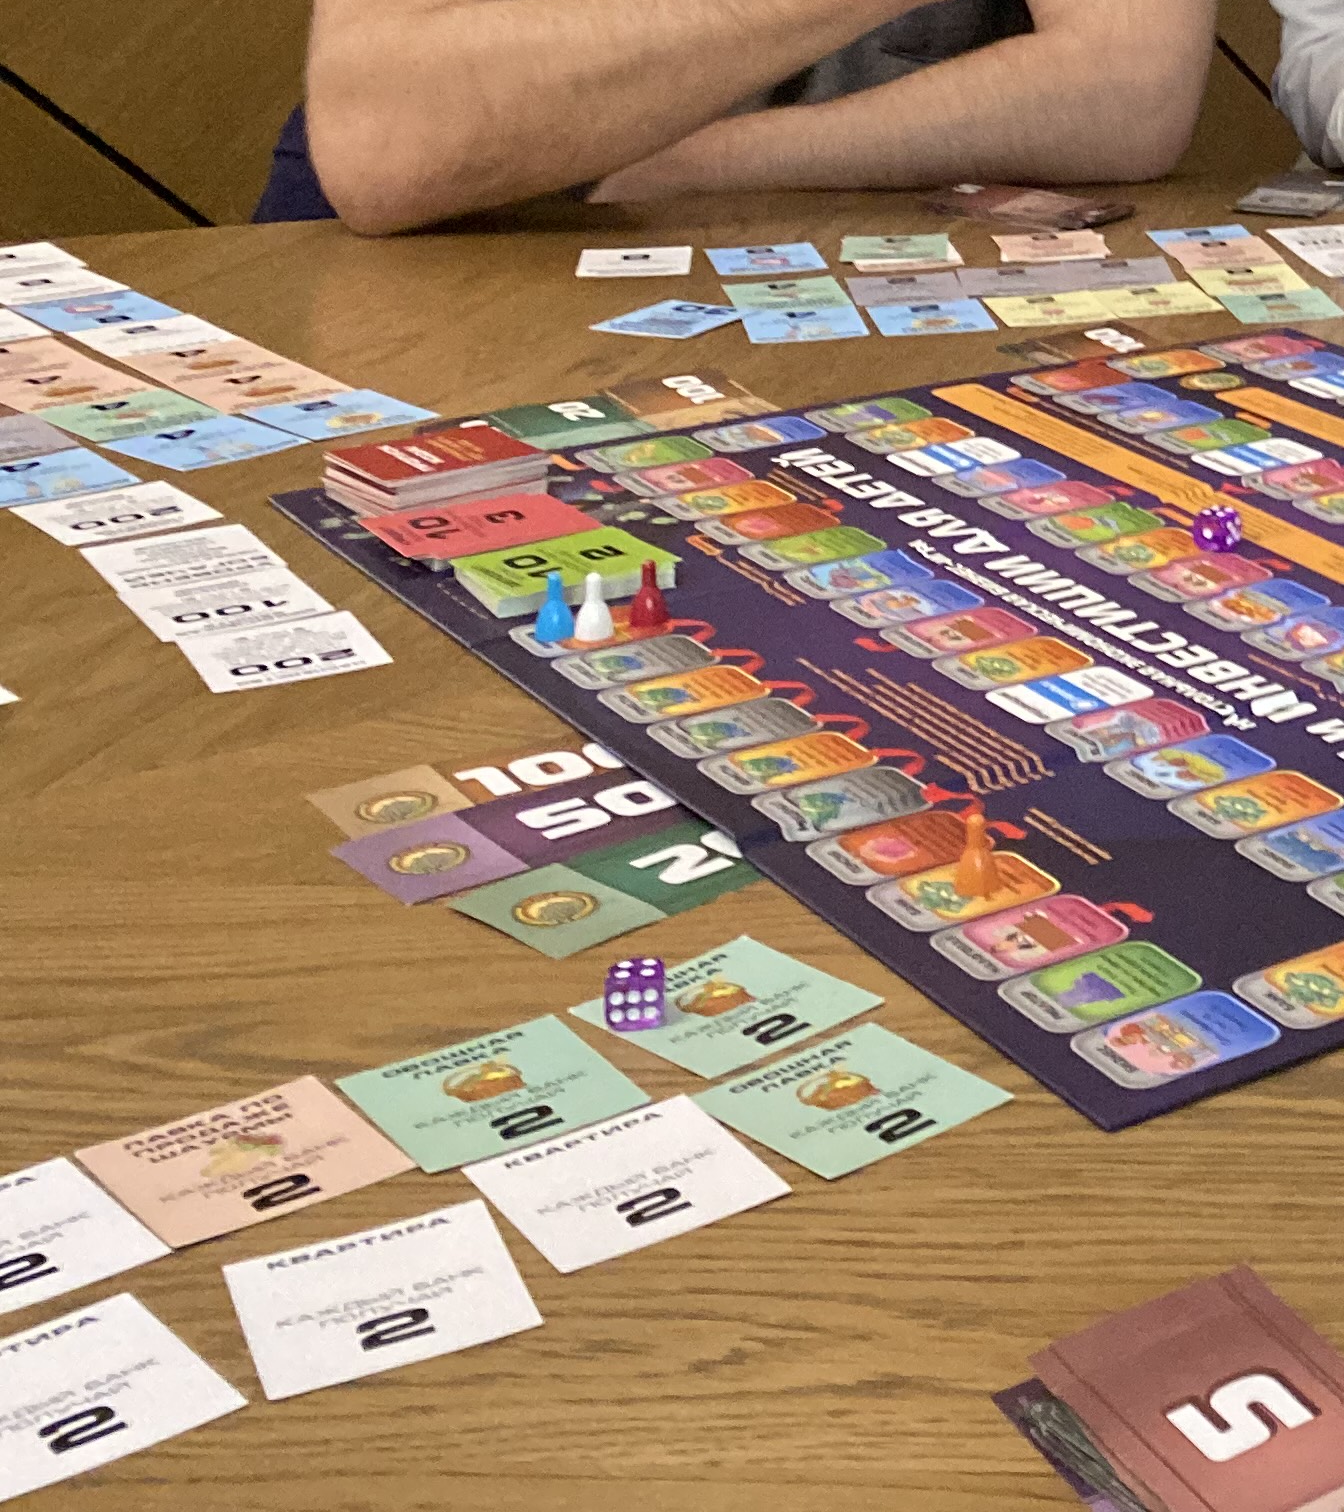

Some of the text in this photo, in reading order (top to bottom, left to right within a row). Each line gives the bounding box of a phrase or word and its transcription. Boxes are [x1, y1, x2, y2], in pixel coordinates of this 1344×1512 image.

[661, 374, 726, 405] 100
[547, 401, 606, 423] 20
[770, 447, 925, 510] ДЕТЕЙ
[404, 513, 466, 541] 10
[480, 508, 528, 525] 3
[899, 506, 1011, 556] ДЛЯ
[497, 551, 569, 579] 10
[574, 544, 628, 561] 2
[172, 599, 289, 625] 100
[996, 554, 1318, 724] ИНВЕСТИЦИИ
[515, 780, 677, 840] 50
[754, 979, 813, 1005] БАНК
[735, 1010, 814, 1046] 2
[377, 1029, 527, 1080] ОВОЩНАЯ
[408, 1044, 513, 1080] ЛАВКА
[724, 1039, 856, 1095] ОВОЩНАЯ
[756, 1053, 850, 1093] ЛАВКА
[520, 1070, 590, 1096] БАНК
[878, 1071, 939, 1099] БАНК
[119, 1092, 287, 1152] ЛАВКА ПО
[128, 1100, 295, 1160] ПРОДАЖЕ
[146, 1111, 297, 1165] ШАУРМЫ
[484, 1102, 567, 1141] 2
[500, 1109, 666, 1170] КВАРТИРА
[858, 1105, 940, 1145] 2
[276, 1134, 352, 1163] БАНК
[649, 1147, 717, 1175] БАНК
[236, 1170, 326, 1213] 2
[610, 1183, 696, 1229] 2
[264, 1214, 453, 1272] КВАРТИРА
[0, 1252, 59, 1288] 2
[409, 1264, 486, 1293] БАНК
[352, 1304, 437, 1352] 2
[31, 1402, 132, 1456] 2
[1165, 1372, 1317, 1464] 5
